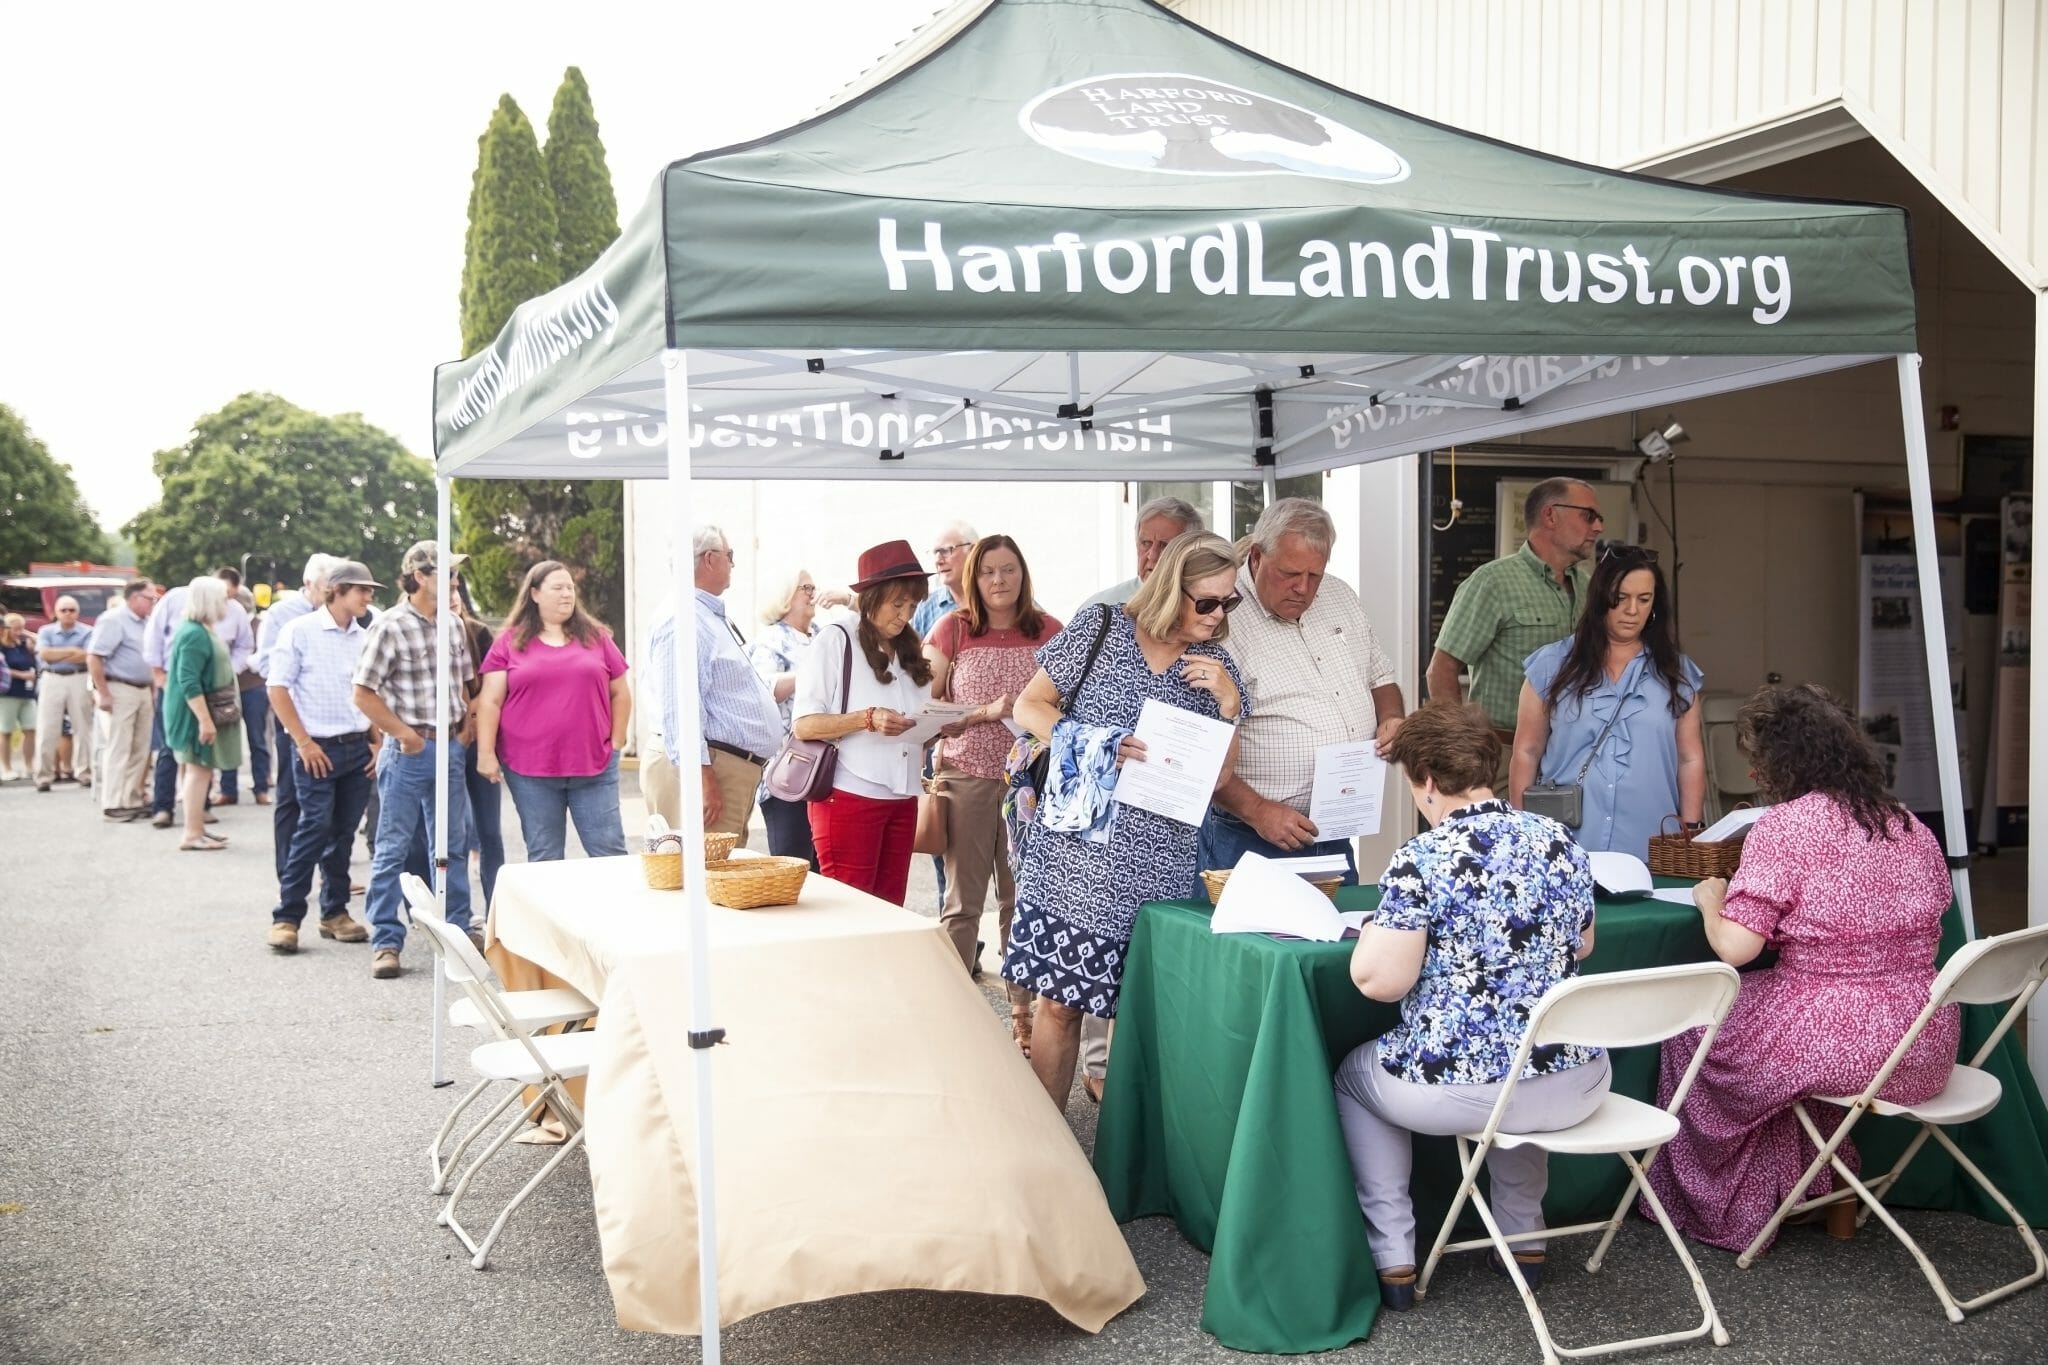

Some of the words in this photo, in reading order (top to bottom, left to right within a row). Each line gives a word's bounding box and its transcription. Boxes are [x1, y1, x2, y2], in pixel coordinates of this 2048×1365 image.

[1094, 101, 1202, 116] LAND
[1109, 113, 1232, 129] TRUST
[876, 217, 1793, 326] HarfordLandTrust.org
